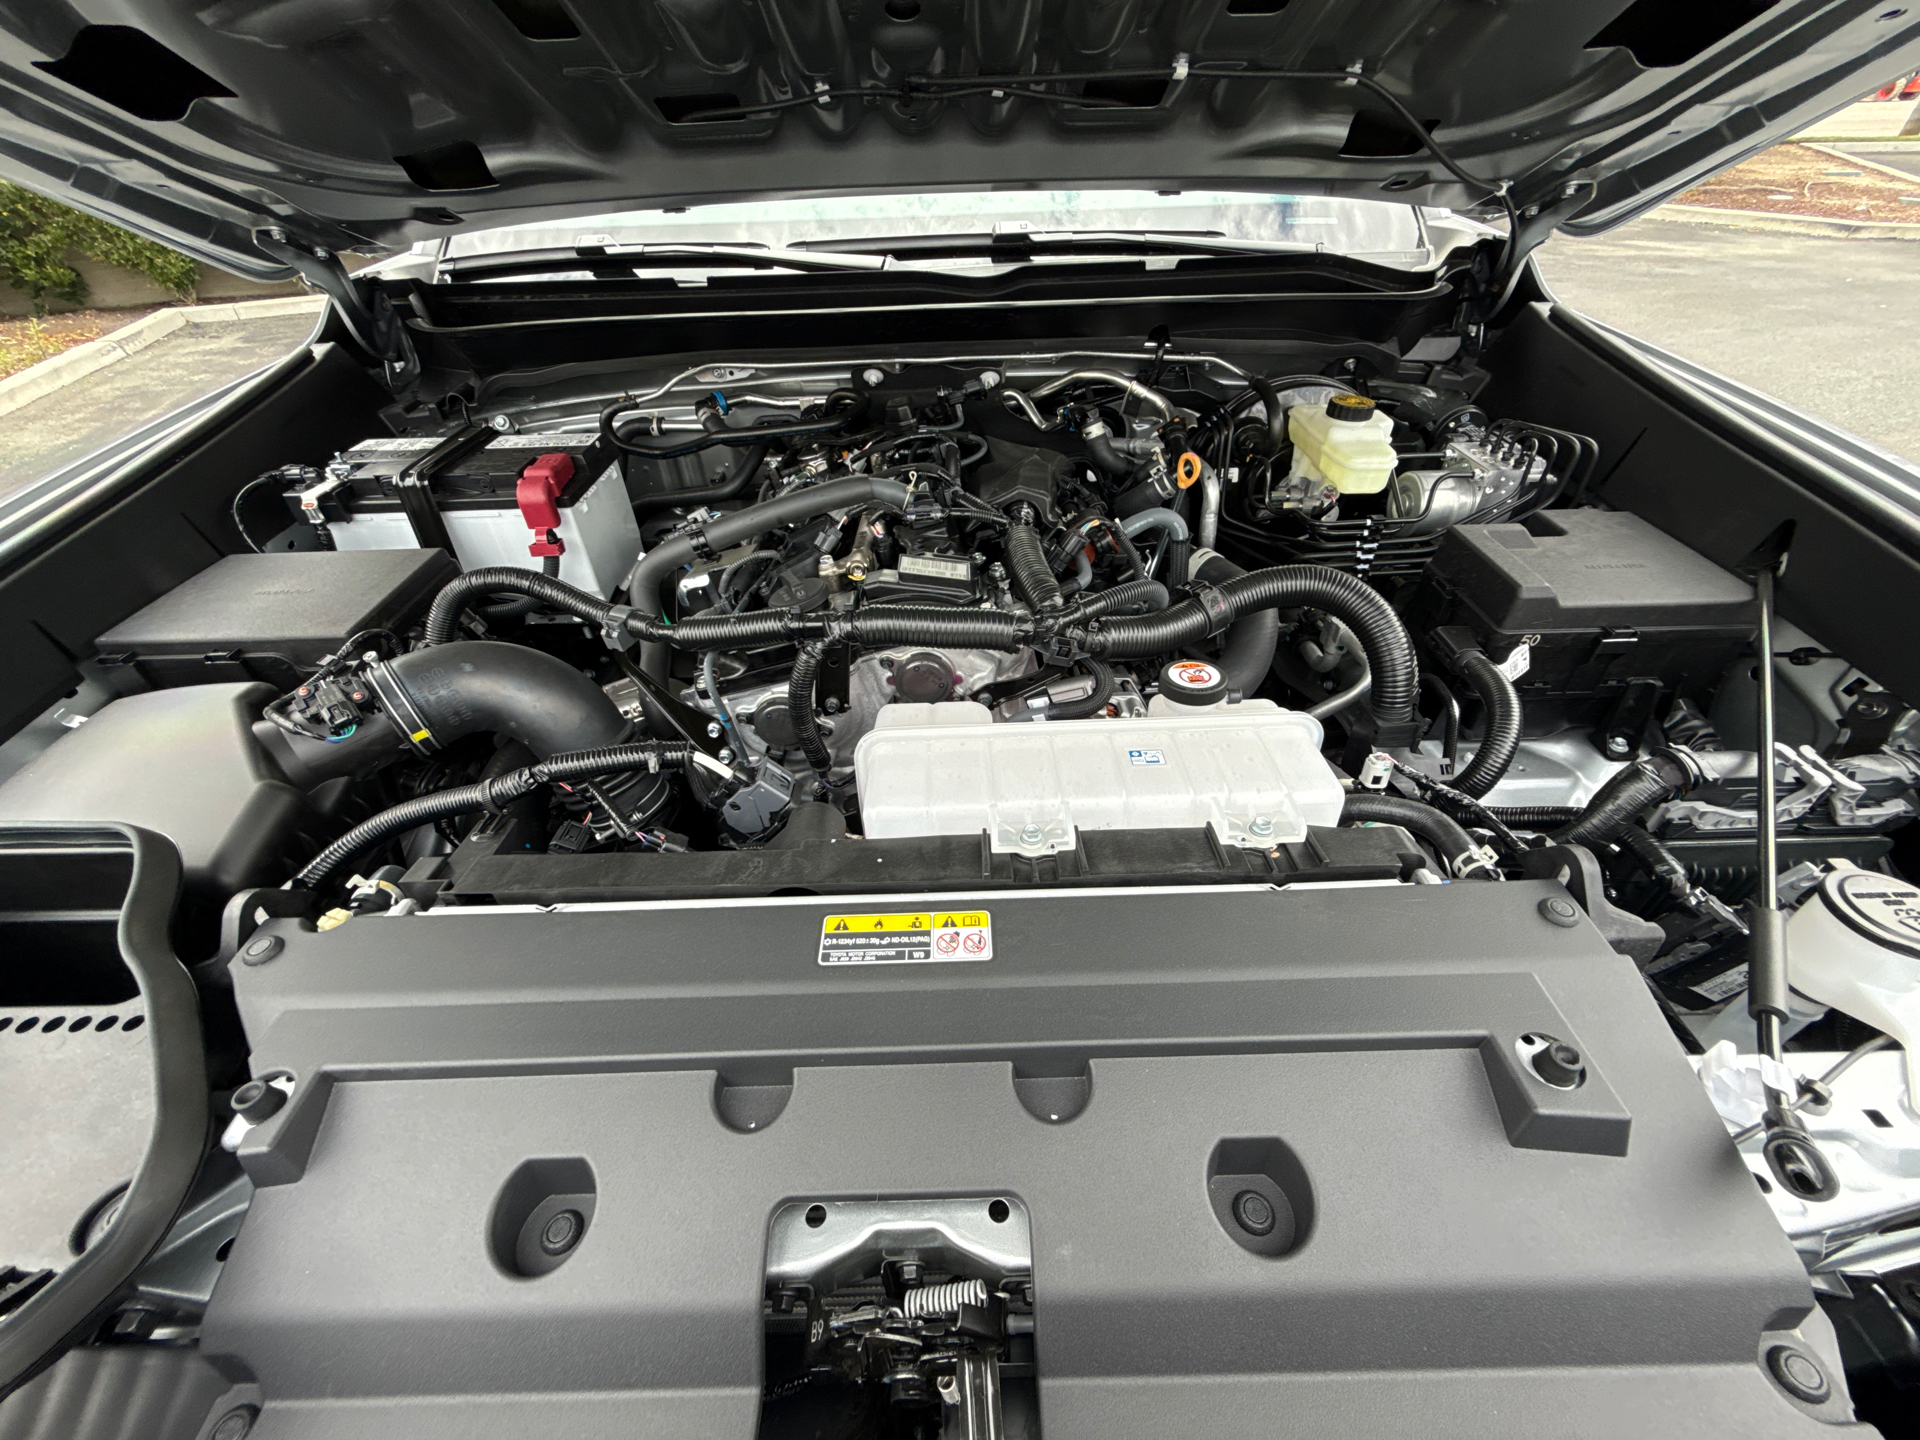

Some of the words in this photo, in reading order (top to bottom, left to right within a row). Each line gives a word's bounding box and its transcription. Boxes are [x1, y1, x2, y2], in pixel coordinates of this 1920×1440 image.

[1519, 634, 1541, 646] 50
[913, 951, 925, 959] W9
[811, 1318, 824, 1343] B9
